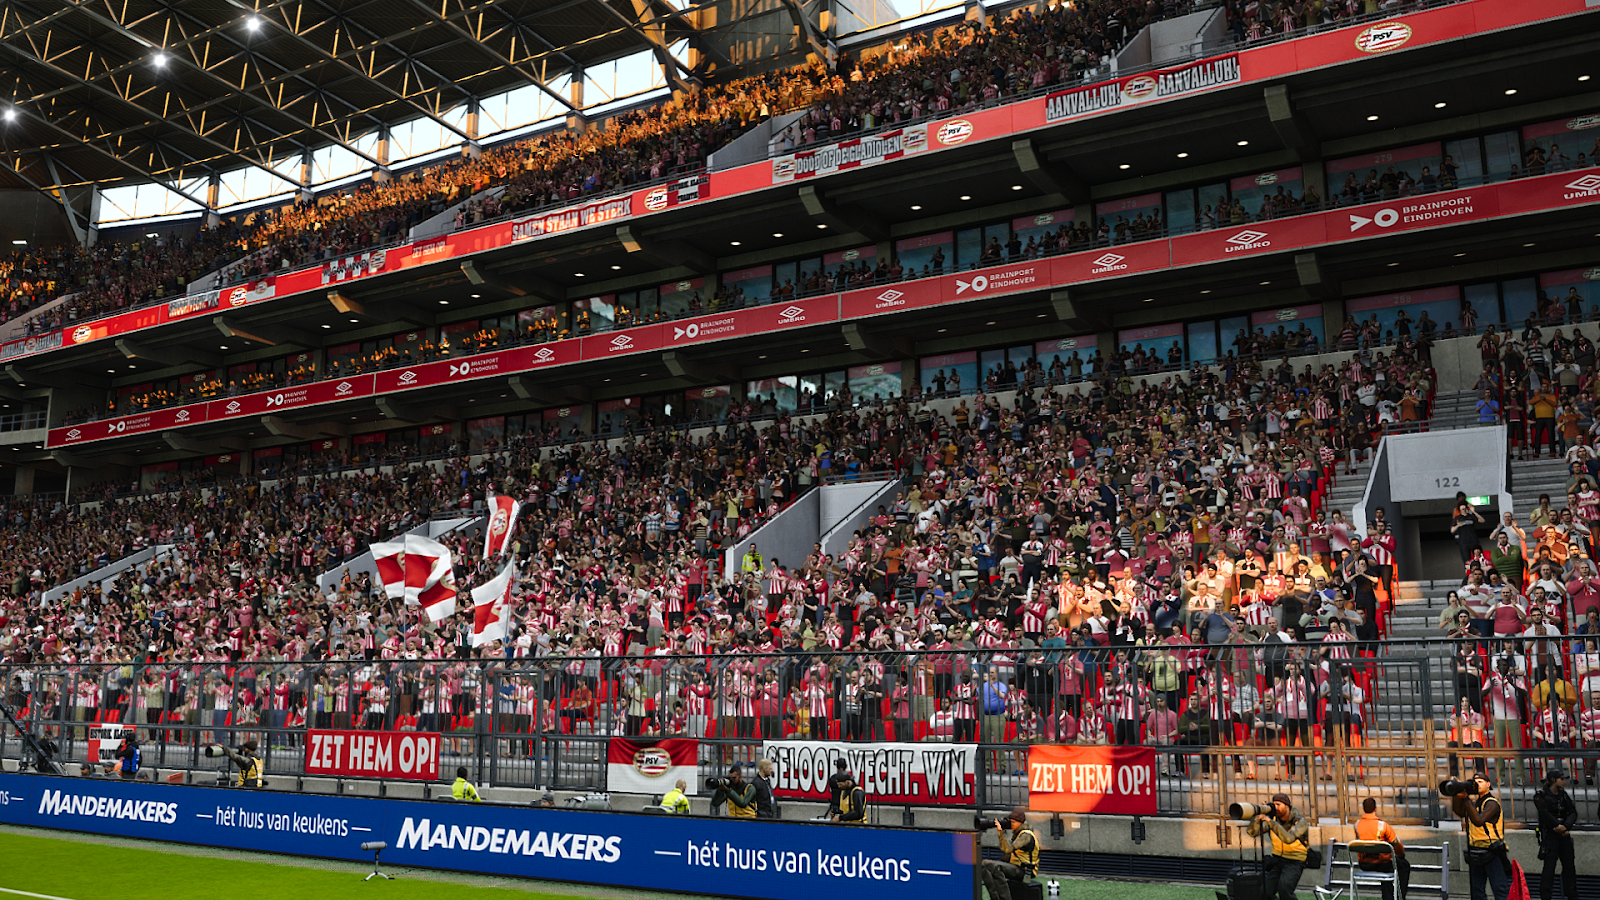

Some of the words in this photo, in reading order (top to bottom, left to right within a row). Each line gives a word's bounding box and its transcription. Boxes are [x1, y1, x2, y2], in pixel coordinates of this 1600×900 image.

[1373, 31, 1394, 40] PSV
[1048, 82, 1121, 120] AANVALLUH!
[1157, 56, 1238, 96] AANVALLUH!
[948, 127, 962, 136] PSV
[796, 154, 820, 174] DOOD
[820, 149, 835, 169] OF
[835, 148, 849, 166] DE
[849, 136, 900, 162] GLADIOLEN
[1374, 154, 1392, 164] 279
[1402, 196, 1472, 214] BRAINPORT
[512, 218, 545, 240] SAMEN
[546, 211, 579, 233] STAAN
[580, 208, 596, 226] WE
[598, 199, 631, 222] STERK
[1403, 206, 1474, 223] EINDHOVEN
[1225, 240, 1270, 252] UMBRO
[990, 268, 1035, 281] BRAINPORT
[1092, 264, 1128, 274] UMBRO
[990, 276, 1036, 288] EINDHOVEN
[876, 300, 906, 308] UMBRO
[700, 318, 735, 328] BRAINPORT
[778, 316, 806, 324] UMBRO
[700, 326, 735, 336] EINDHOVEN
[609, 344, 634, 352] UMBRO
[470, 357, 499, 367] BRAINPORT
[532, 356, 555, 364] UMBRO
[1435, 477, 1460, 488] 122
[310, 734, 344, 768] ZET
[350, 734, 393, 772] HEM
[400, 736, 436, 774] OP!
[645, 756, 659, 765] PSV
[848, 748, 918, 796] VECHT.
[922, 750, 972, 799] WIN.
[1031, 763, 1066, 792] ZET
[1070, 764, 1114, 794] HEM
[1118, 764, 1150, 796] OP!
[38, 788, 178, 824] MANDEMAKERS
[215, 806, 236, 827] hét
[239, 807, 264, 830] huis
[267, 814, 290, 832] van
[293, 810, 348, 837] keukens
[396, 817, 622, 863] MANDEMAKERS
[687, 840, 720, 868] hét
[726, 843, 767, 871] huis
[772, 851, 810, 874] van
[818, 850, 911, 882] keukens
